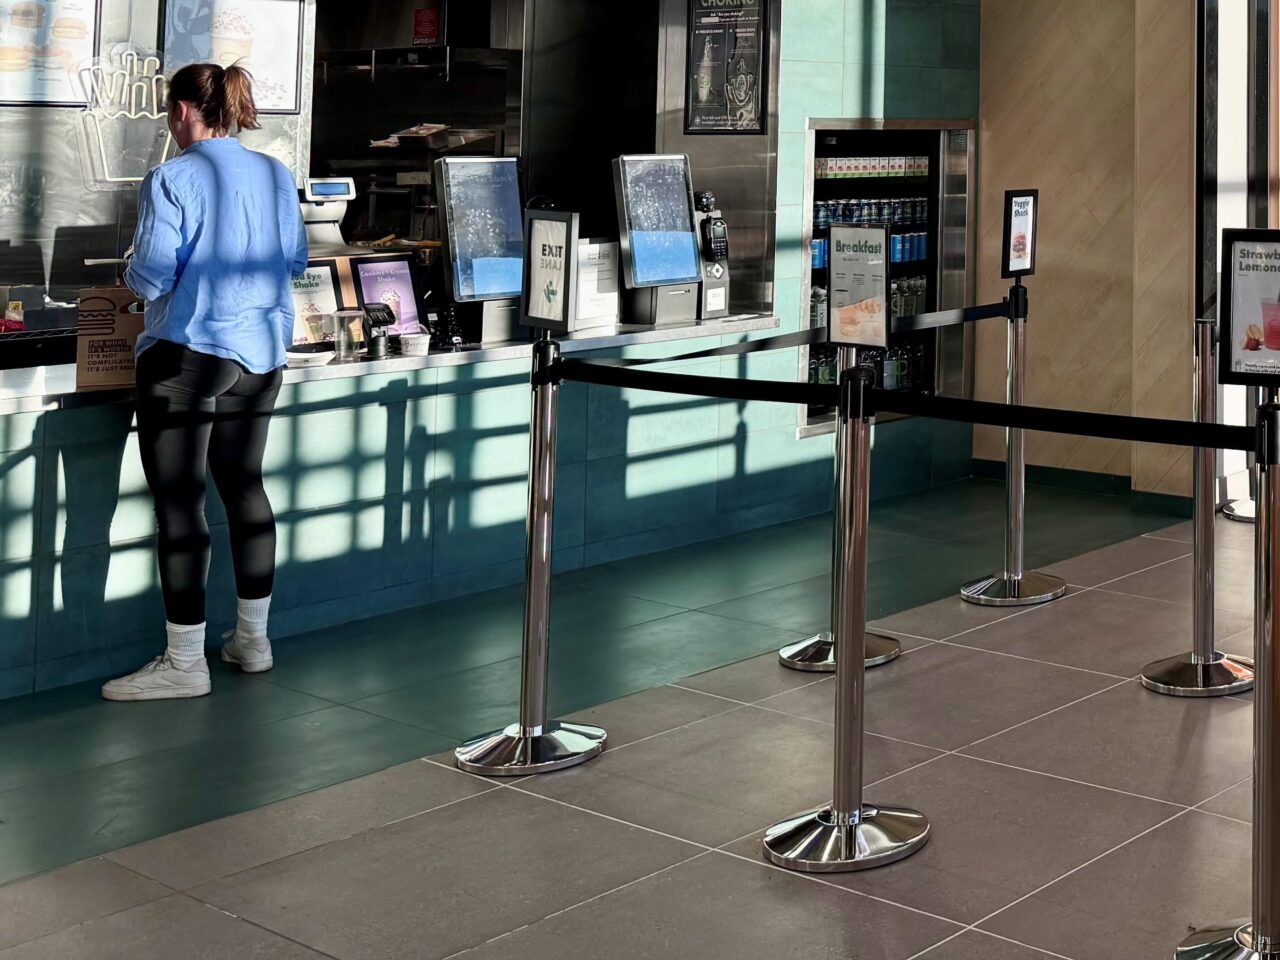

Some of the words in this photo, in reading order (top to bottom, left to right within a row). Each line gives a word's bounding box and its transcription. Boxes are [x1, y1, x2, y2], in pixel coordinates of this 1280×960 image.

[1014, 199, 1029, 209] Veggie
[1014, 209, 1028, 217] Shack
[541, 243, 563, 258] EXIT
[835, 240, 882, 254] Breakfast
[307, 272, 322, 280] Eye
[293, 281, 320, 289] Shake
